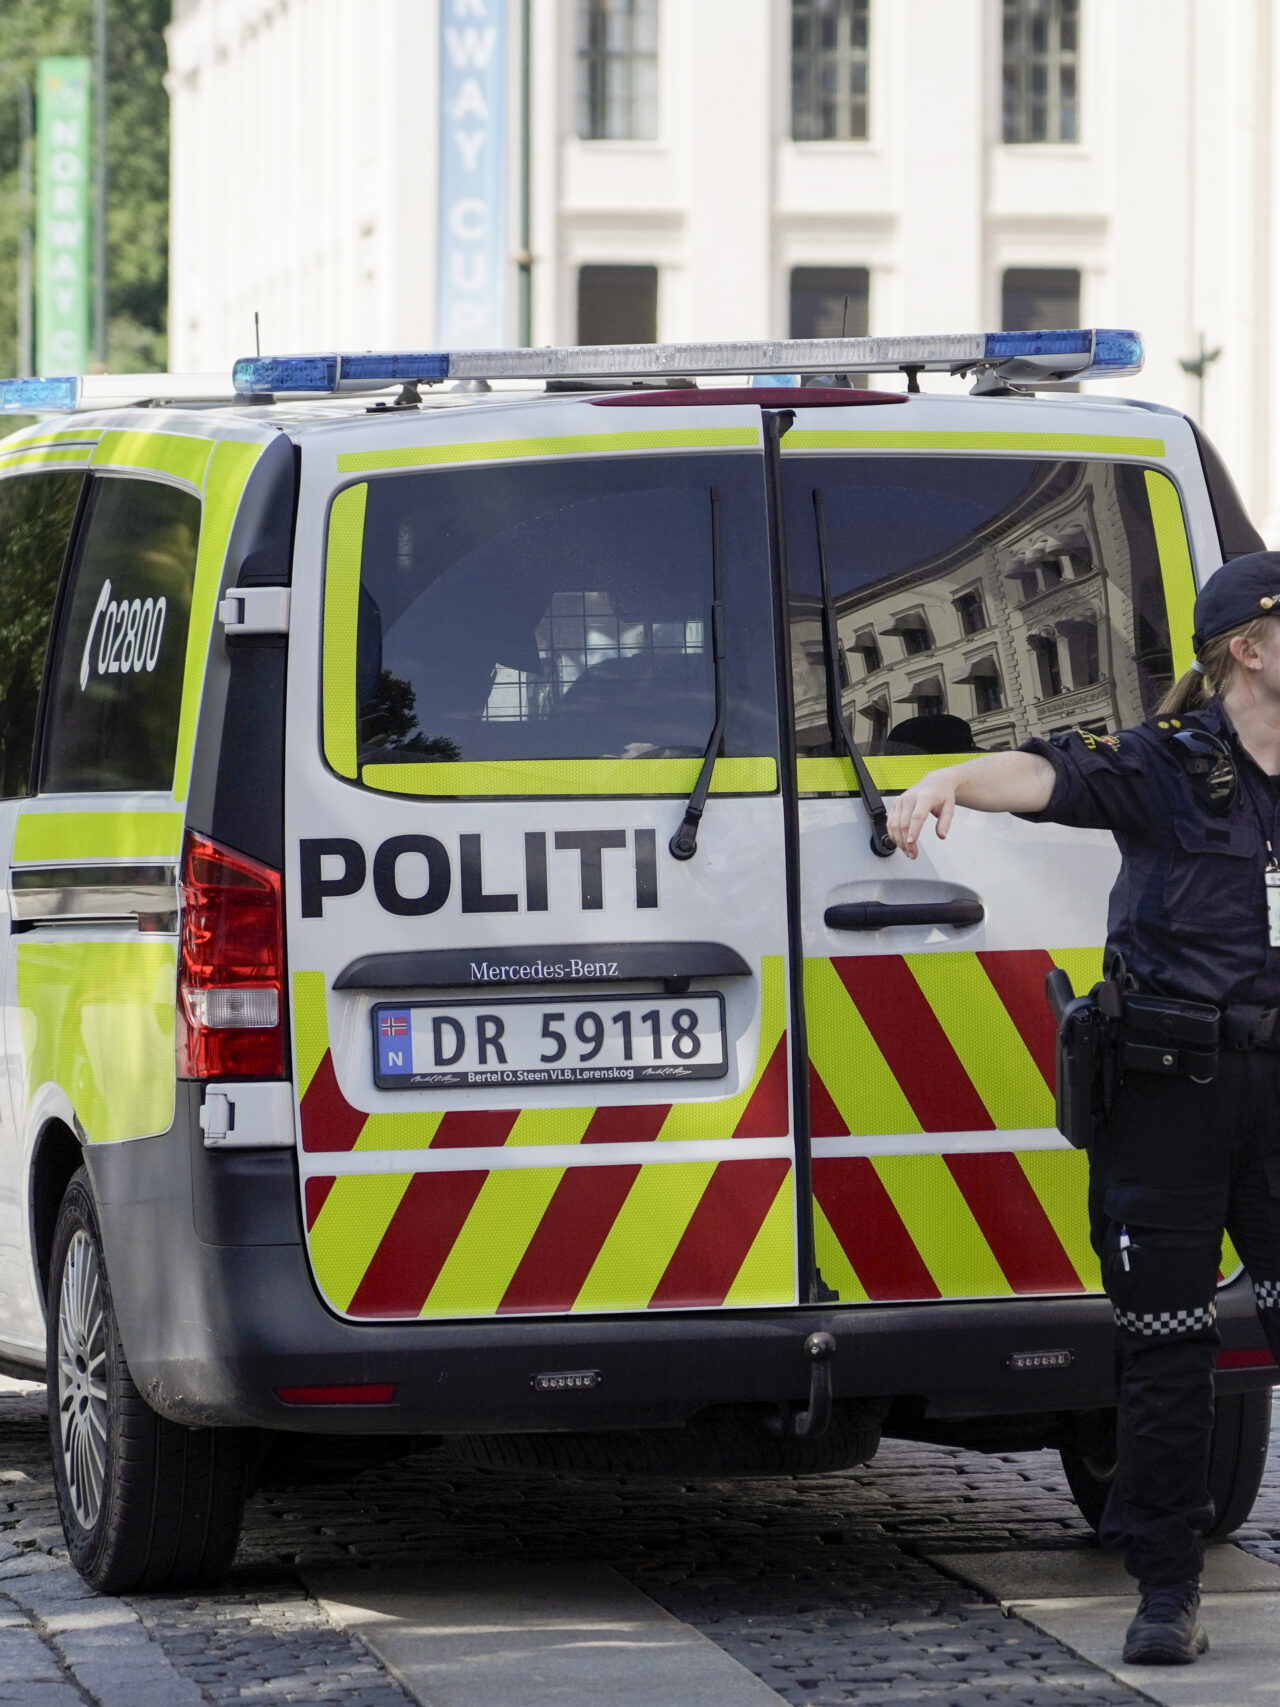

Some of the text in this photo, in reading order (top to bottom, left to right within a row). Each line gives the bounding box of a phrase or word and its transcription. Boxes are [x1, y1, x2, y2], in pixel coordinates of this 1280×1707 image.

[48, 118, 86, 318] NORWAY
[450, 196, 490, 342] CUP
[98, 596, 167, 675] 02800
[299, 828, 659, 919] POLITI
[470, 959, 619, 981] Mercedes-Benz
[388, 1051, 404, 1067] N
[432, 1008, 701, 1067] DR 59118
[468, 1071, 501, 1083] Bertel
[504, 1071, 516, 1082] O.
[517, 1070, 548, 1082] Steen
[550, 1069, 575, 1081] VLB,
[577, 1067, 634, 1080] Lørenskog
